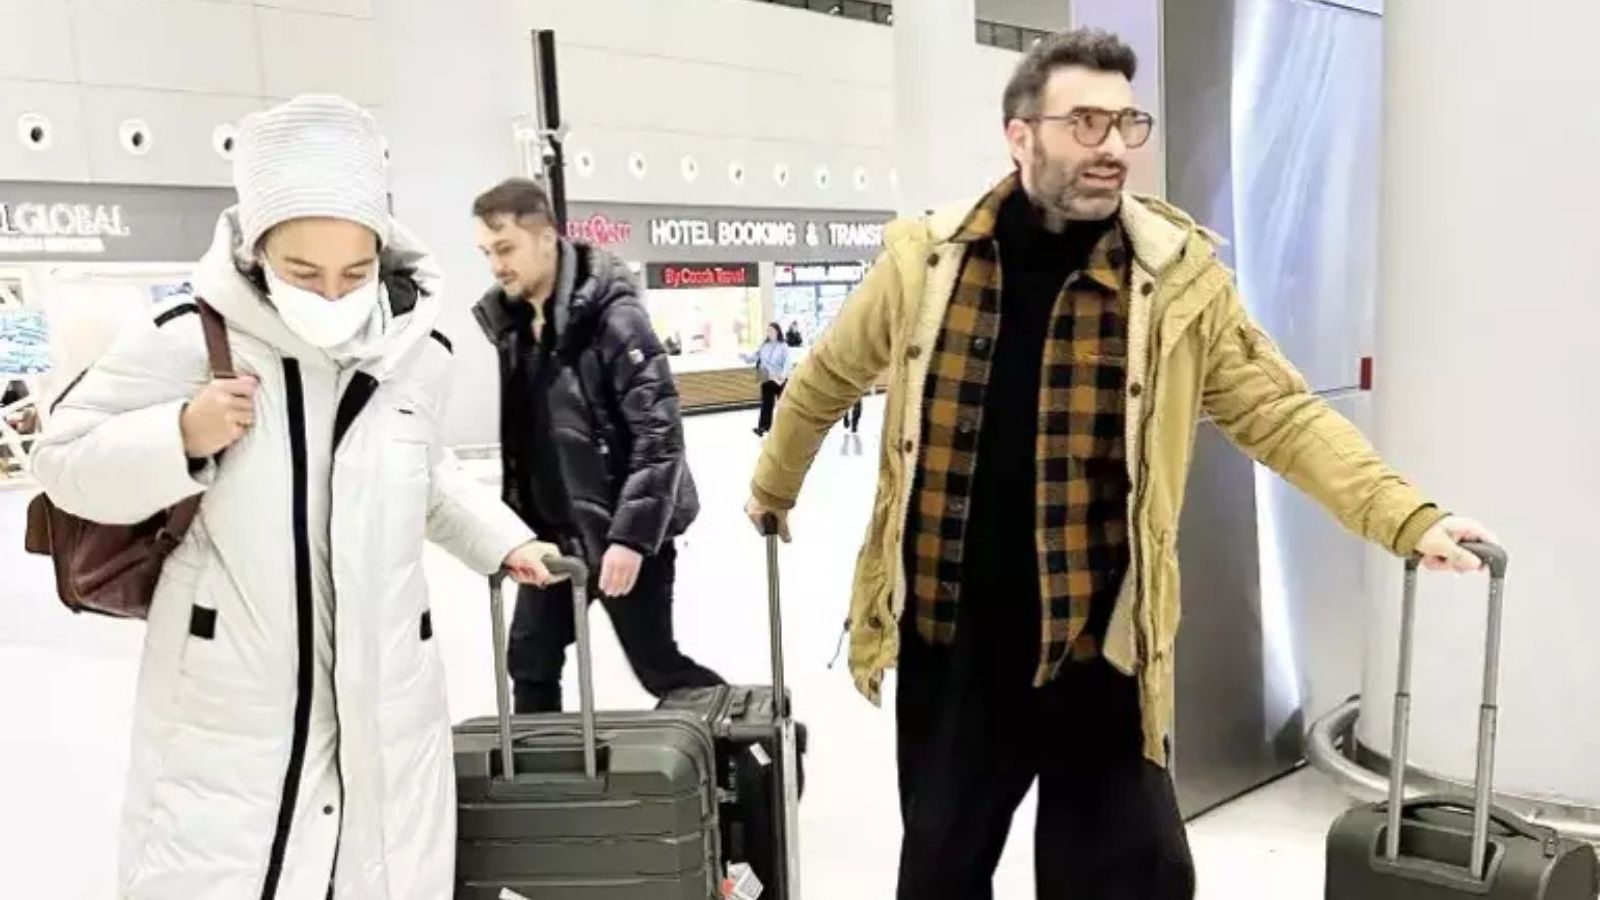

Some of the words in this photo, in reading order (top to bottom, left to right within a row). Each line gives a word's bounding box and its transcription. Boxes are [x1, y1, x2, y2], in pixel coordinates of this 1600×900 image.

[651, 219, 715, 246] HOTEL
[718, 220, 797, 247] BOOKING
[805, 220, 819, 247] &
